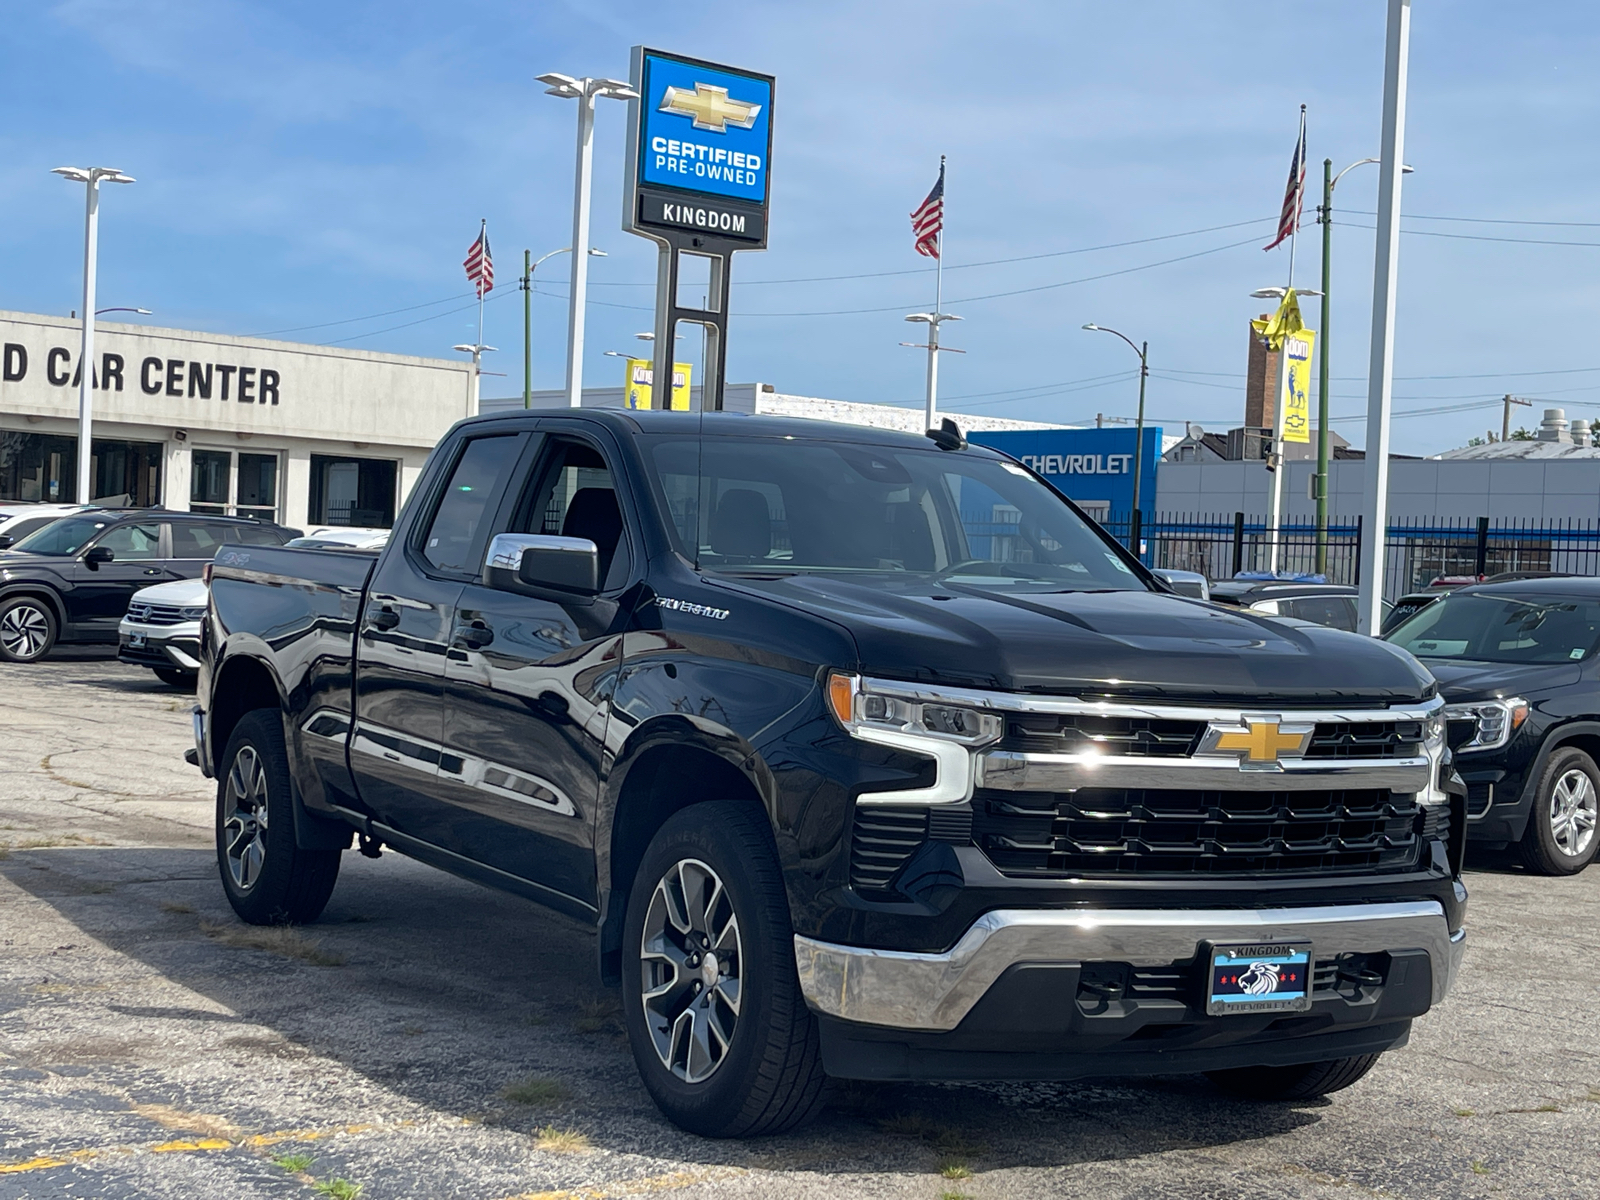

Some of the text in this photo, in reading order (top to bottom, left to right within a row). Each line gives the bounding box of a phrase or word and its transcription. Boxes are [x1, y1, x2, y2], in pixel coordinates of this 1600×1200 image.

[652, 136, 761, 171] CERTIFIED
[656, 154, 756, 186] PRE-OWNED
[663, 203, 745, 233] KINGDOM
[140, 356, 281, 406] CENTER
[1236, 945, 1291, 957] KINGDOM
